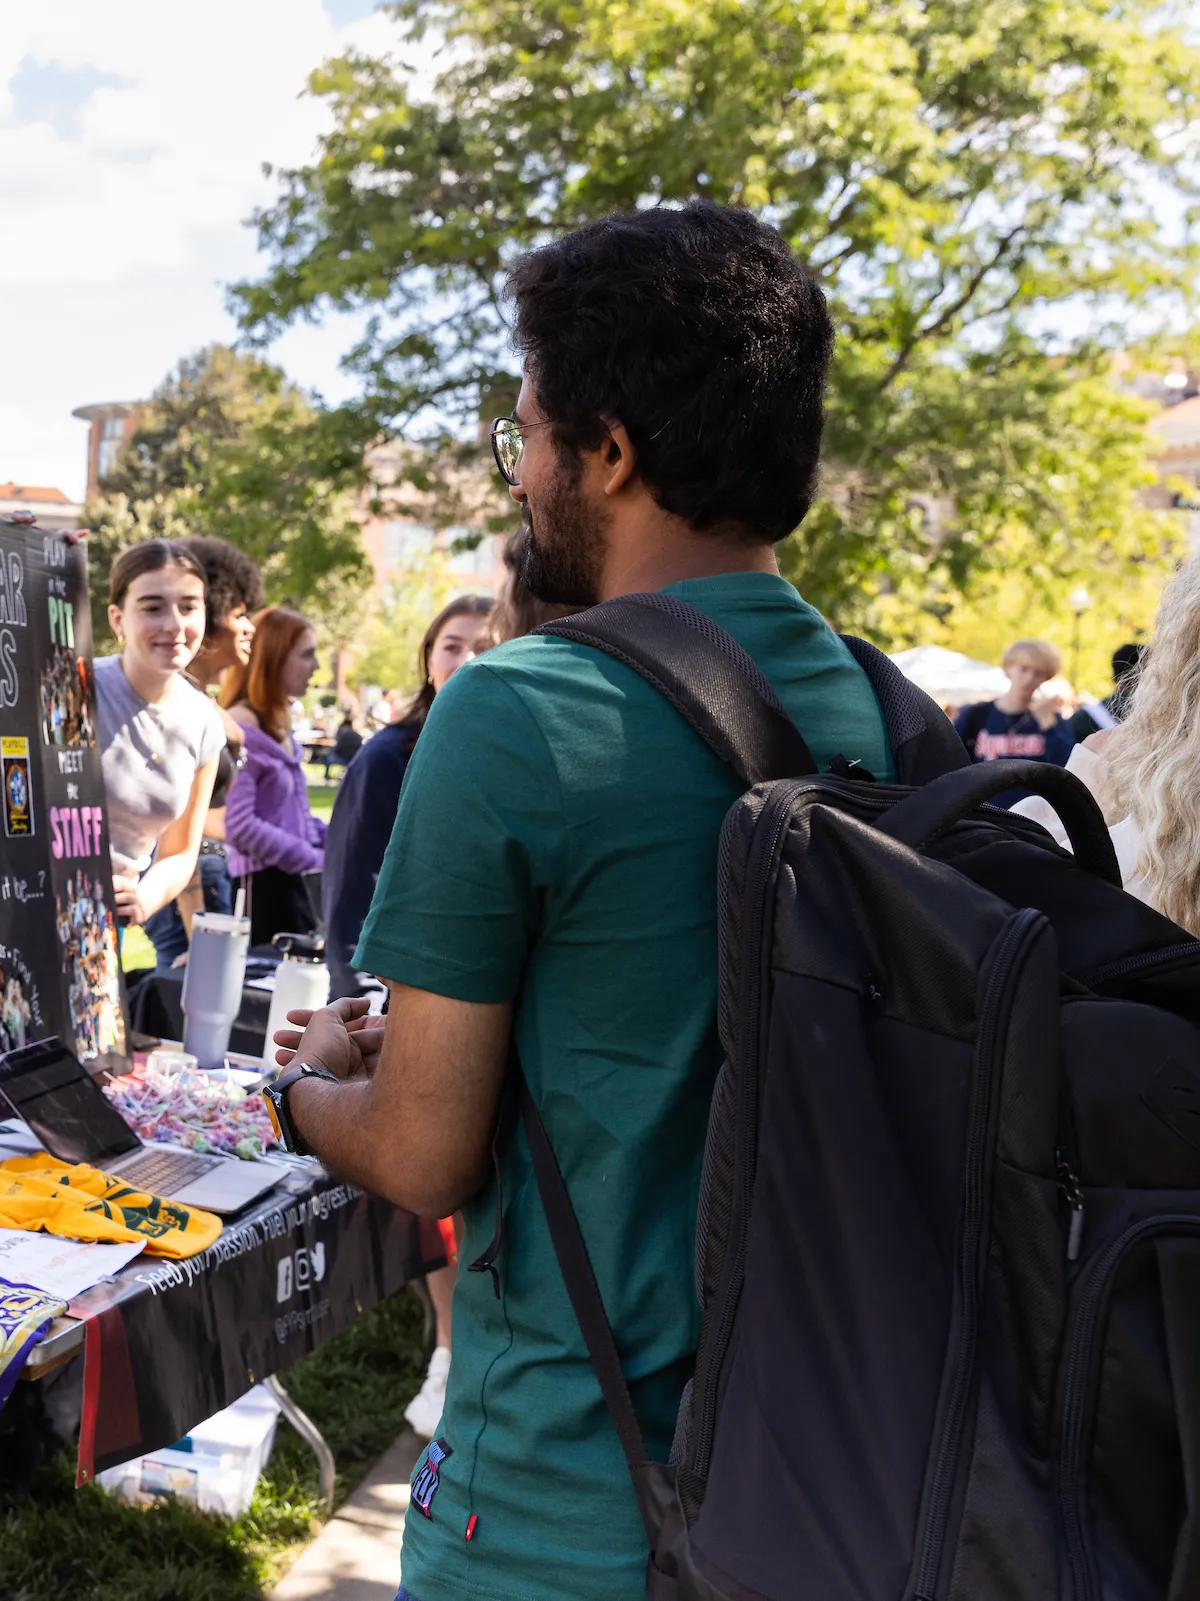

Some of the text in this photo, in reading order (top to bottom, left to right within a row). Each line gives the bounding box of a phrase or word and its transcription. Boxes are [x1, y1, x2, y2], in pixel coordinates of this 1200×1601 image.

[48, 595, 75, 649] PIT
[57, 750, 84, 774] MEET
[50, 806, 103, 859] STAFF
